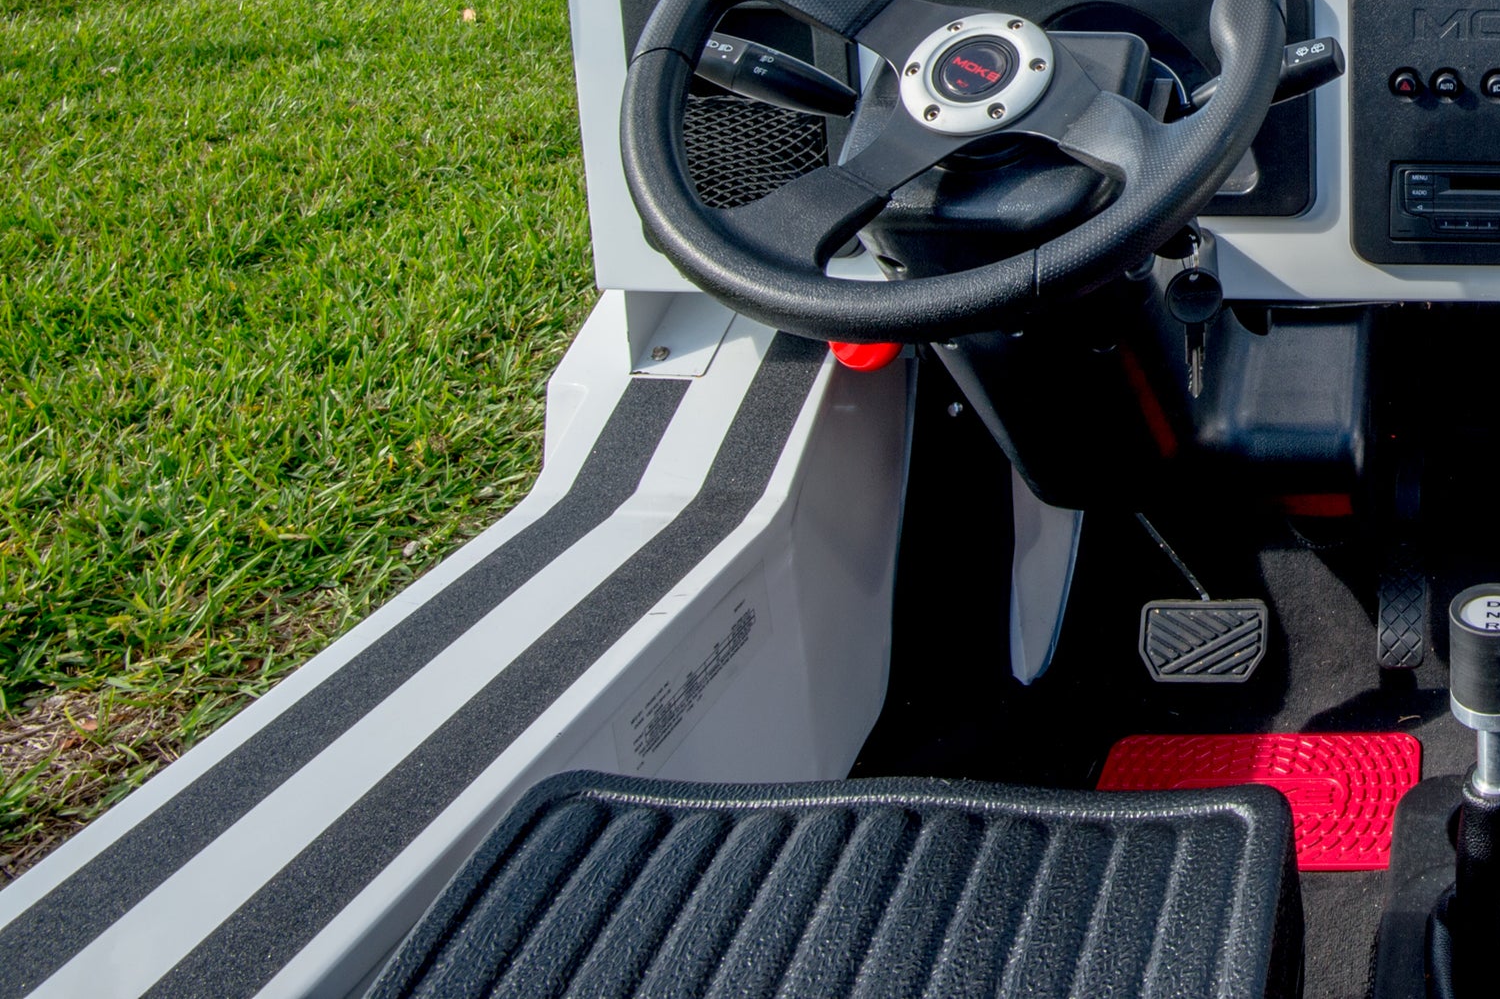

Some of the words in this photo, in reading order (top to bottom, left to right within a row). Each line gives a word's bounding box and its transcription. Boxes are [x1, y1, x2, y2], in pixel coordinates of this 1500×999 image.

[753, 66, 769, 76] OFF
[1440, 82, 1454, 90] AUTO
[1485, 622, 1500, 630] R
